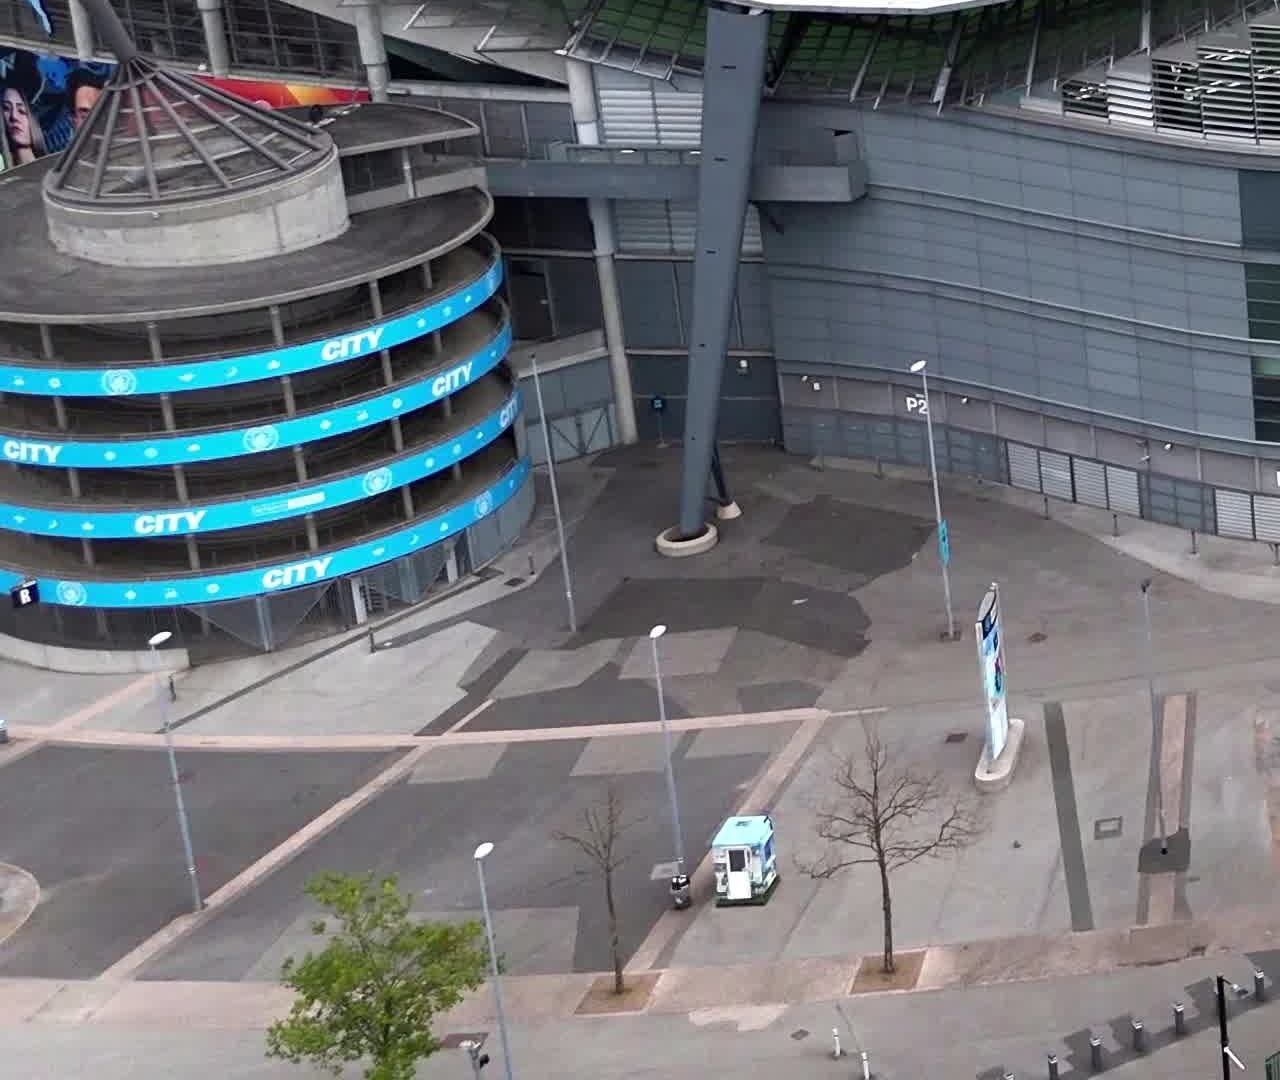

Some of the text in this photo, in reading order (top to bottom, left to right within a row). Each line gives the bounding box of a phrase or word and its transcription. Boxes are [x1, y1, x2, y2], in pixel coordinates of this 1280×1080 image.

[321, 326, 386, 362] CITY
[431, 362, 473, 397] CITY
[906, 396, 929, 415] P2
[3, 439, 64, 464] CITY
[134, 509, 206, 536] CITY
[262, 556, 334, 589] CITY
[20, 588, 32, 605] R
